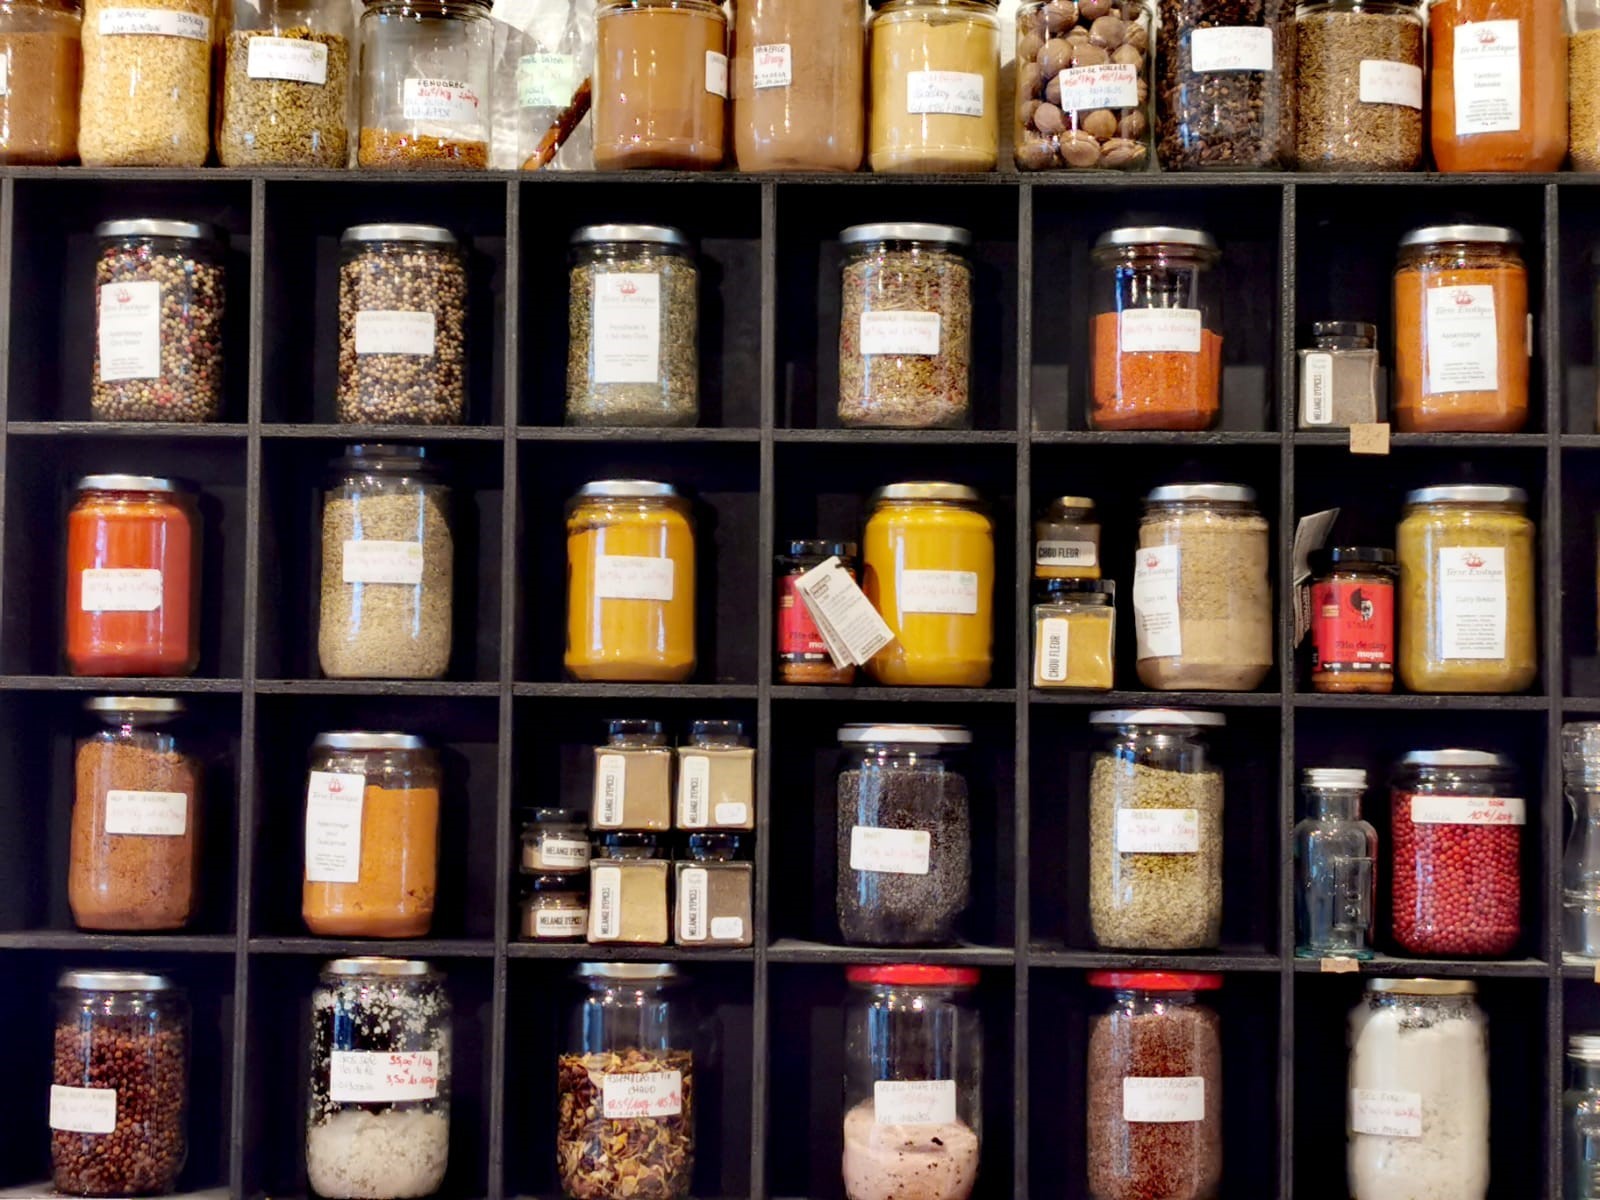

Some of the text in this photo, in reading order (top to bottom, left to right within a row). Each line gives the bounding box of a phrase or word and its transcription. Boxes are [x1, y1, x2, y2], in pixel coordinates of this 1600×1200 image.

[1038, 548, 1079, 559] CHOU FLEUR
[1048, 635, 1060, 678] CHOU FLEUR
[628, 1086, 656, 1095] CHAUD
